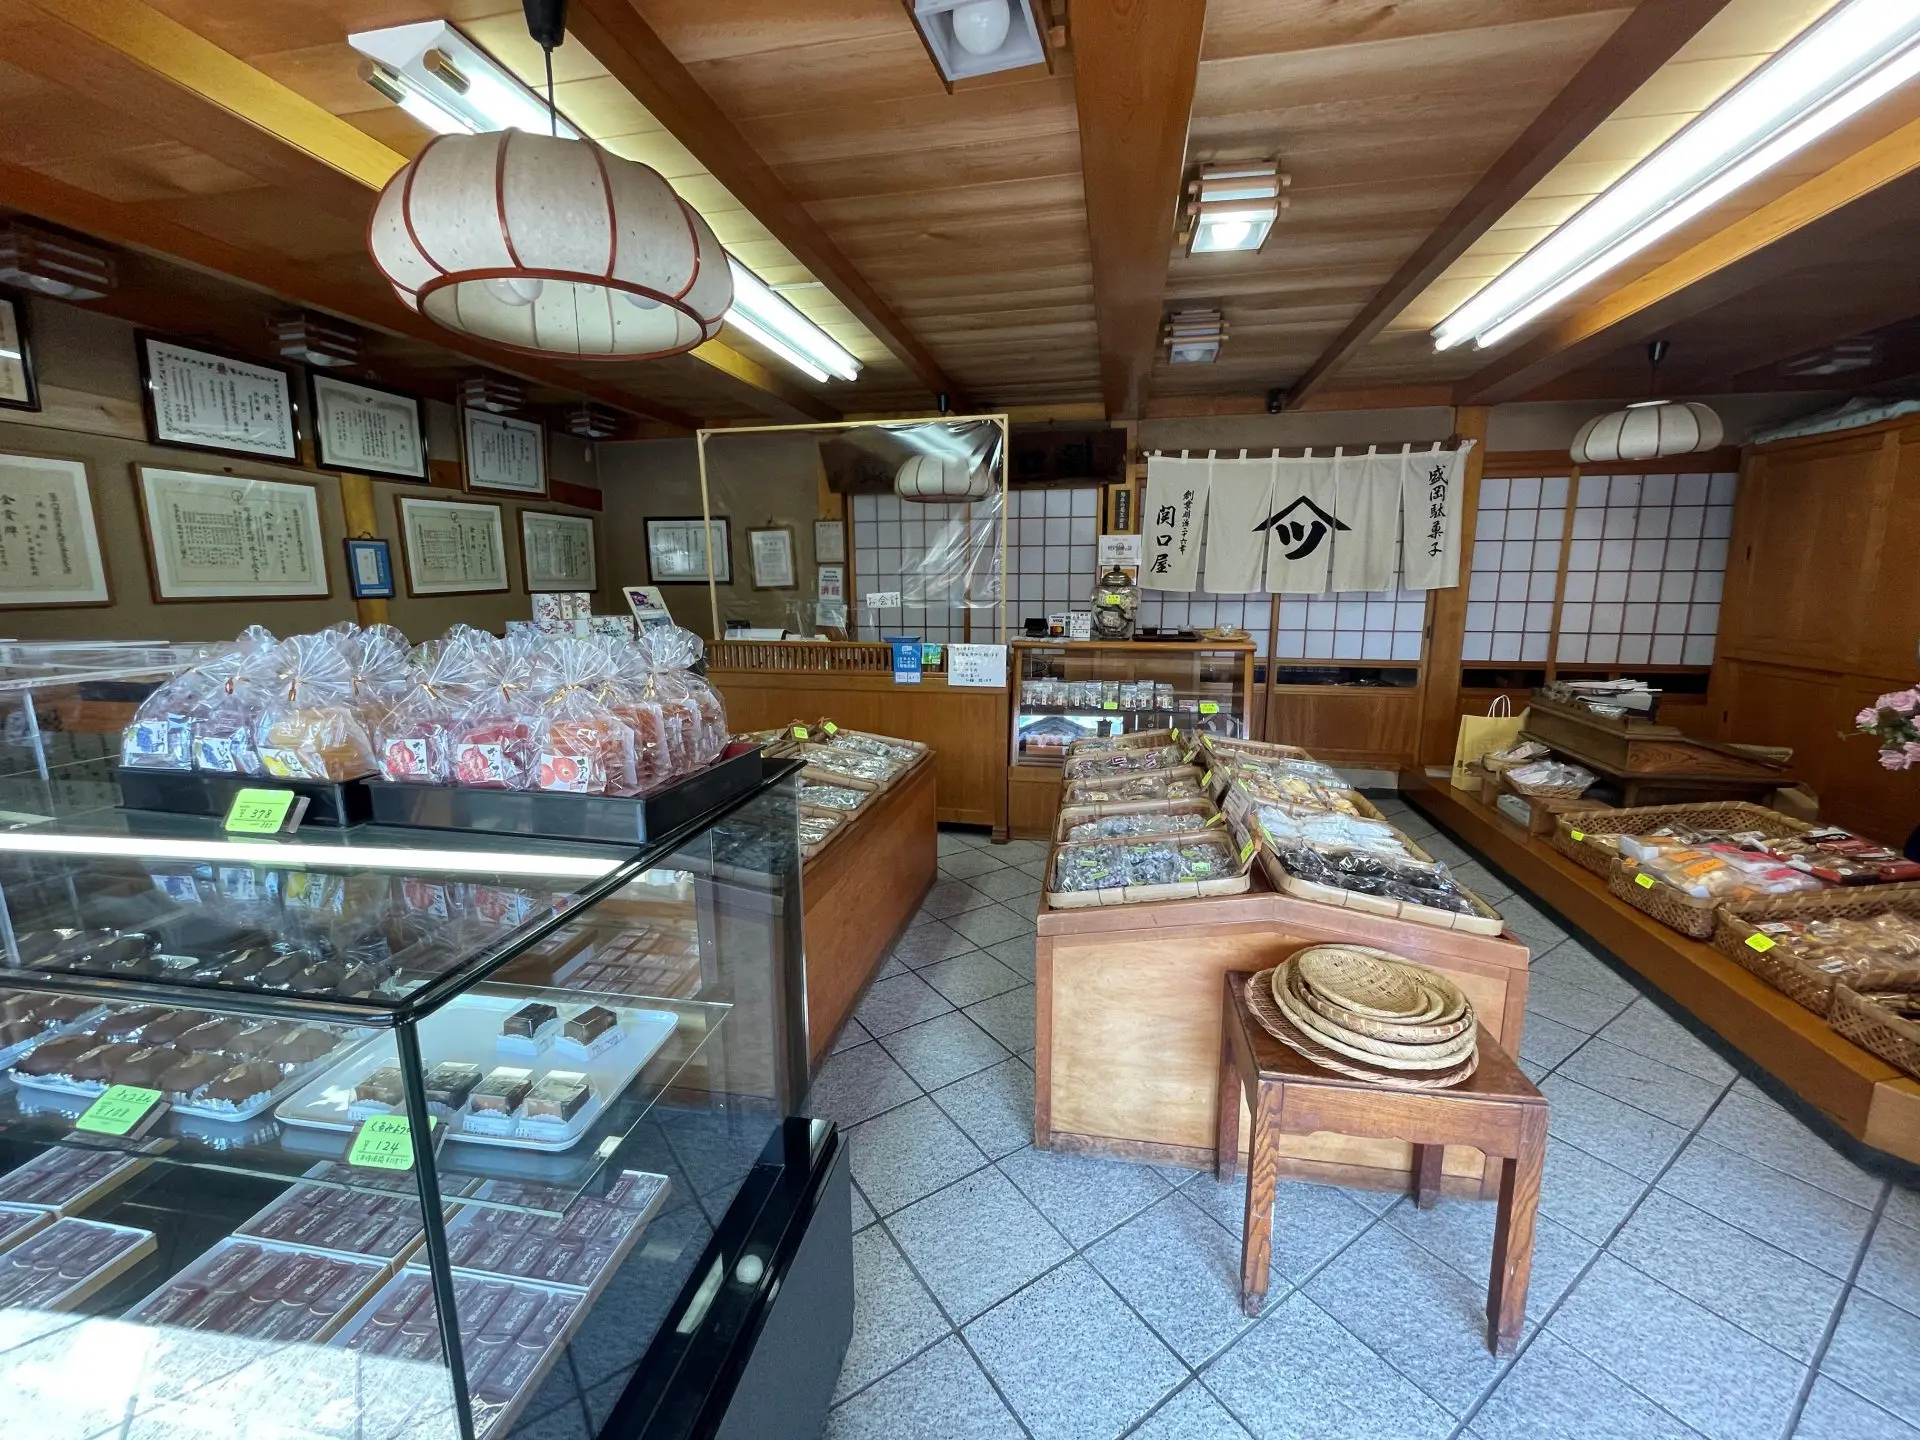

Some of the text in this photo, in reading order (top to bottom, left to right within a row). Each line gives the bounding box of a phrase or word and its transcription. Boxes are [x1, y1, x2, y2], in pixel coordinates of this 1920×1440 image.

[1427, 464, 1449, 557] 盛岡駄菓子
[1150, 504, 1176, 574] 関口屋
[868, 594, 899, 607] お会計
[250, 809, 272, 819] 378
[375, 1141, 400, 1155] 124
